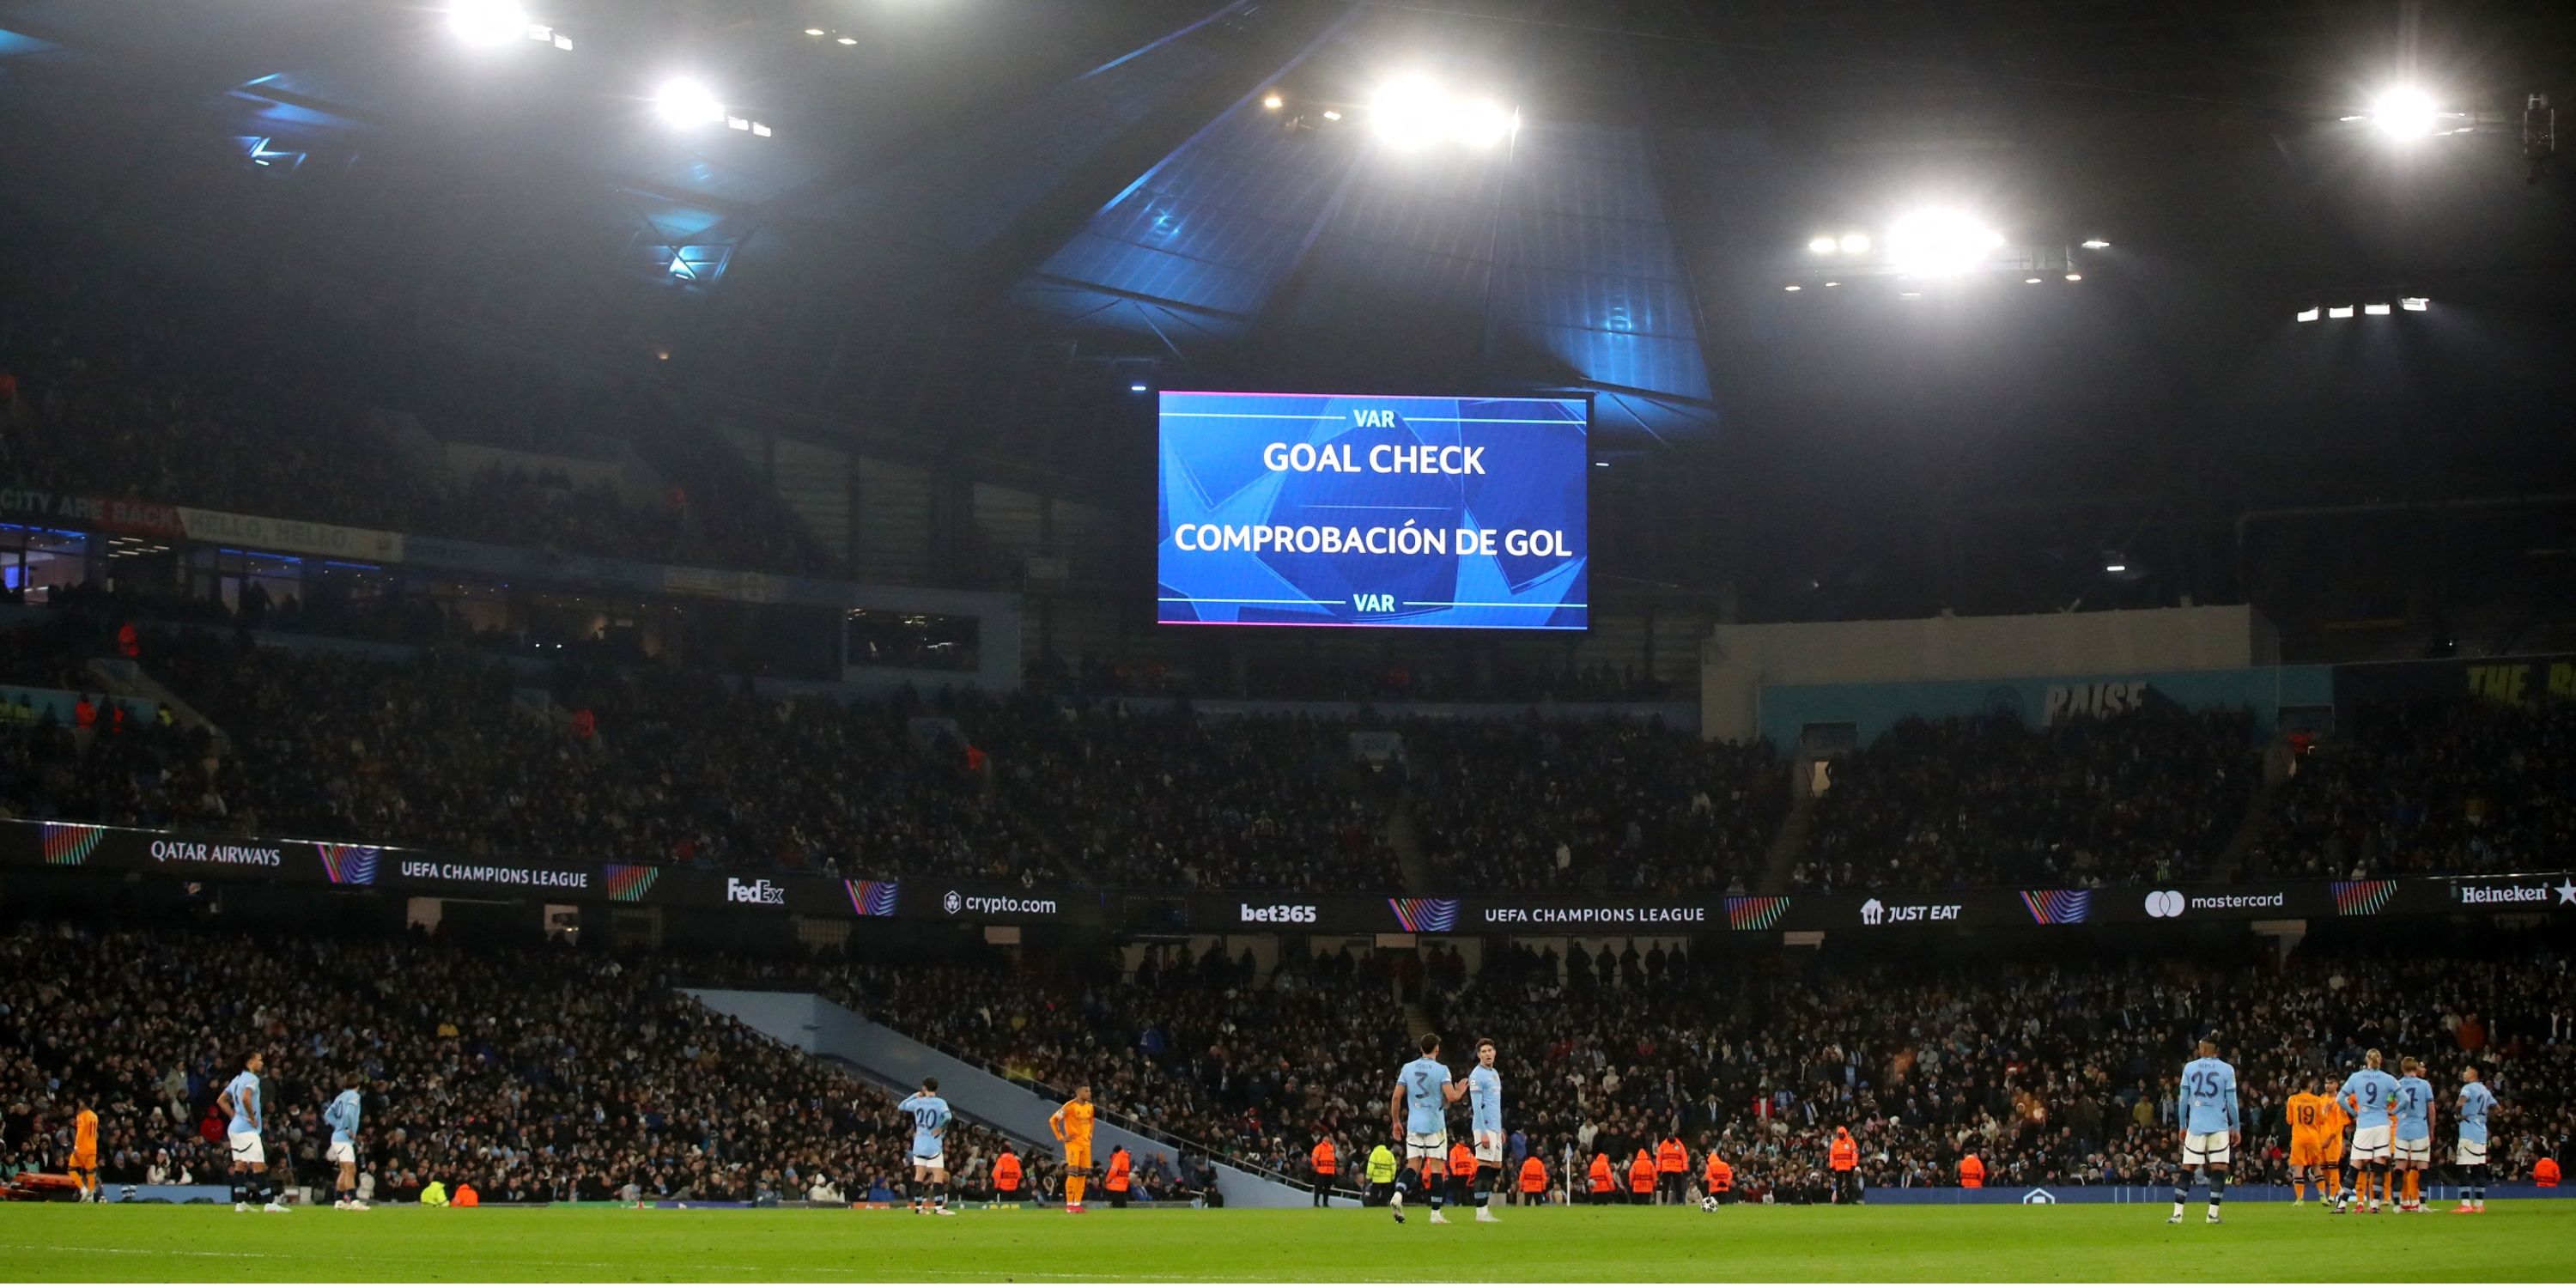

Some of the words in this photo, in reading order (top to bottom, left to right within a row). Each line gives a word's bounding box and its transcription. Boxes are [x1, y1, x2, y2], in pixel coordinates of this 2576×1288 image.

[1353, 410, 1395, 428] VAR
[1263, 442, 1361, 473] GOAL
[1369, 445, 1485, 475] CHECK
[0, 487, 54, 514] CITY
[58, 495, 106, 521] ARE
[1175, 519, 1446, 555] COMPROBACIÓN
[1455, 529, 1498, 556] DE
[1505, 530, 1572, 557] GOL
[1353, 593, 1395, 613] VAR
[2467, 665, 2530, 706] THE
[150, 840, 207, 861] QATAR
[210, 845, 280, 866] AIRWAYS
[401, 860, 439, 878] UEFA
[442, 864, 529, 884] CHAMPIONS
[532, 871, 588, 888] LEAGUE
[727, 878, 784, 904] FedEx
[2192, 892, 2283, 908] mastercard
[2462, 885, 2548, 903] Heineken
[966, 895, 1056, 914] crypto.com
[1241, 903, 1316, 922] bet365
[1485, 908, 1528, 921] UEFA
[1533, 908, 1634, 922] CHAMPIONS
[1639, 908, 1704, 921] LEAGUE
[1888, 906, 1927, 923] JUST
[1930, 905, 1961, 920] EAT
[1414, 1072, 1430, 1098] 3
[2191, 1071, 2220, 1098] 25
[2366, 1082, 2377, 1104] 9
[916, 1108, 937, 1129] 20
[2298, 1104, 2314, 1125] 19
